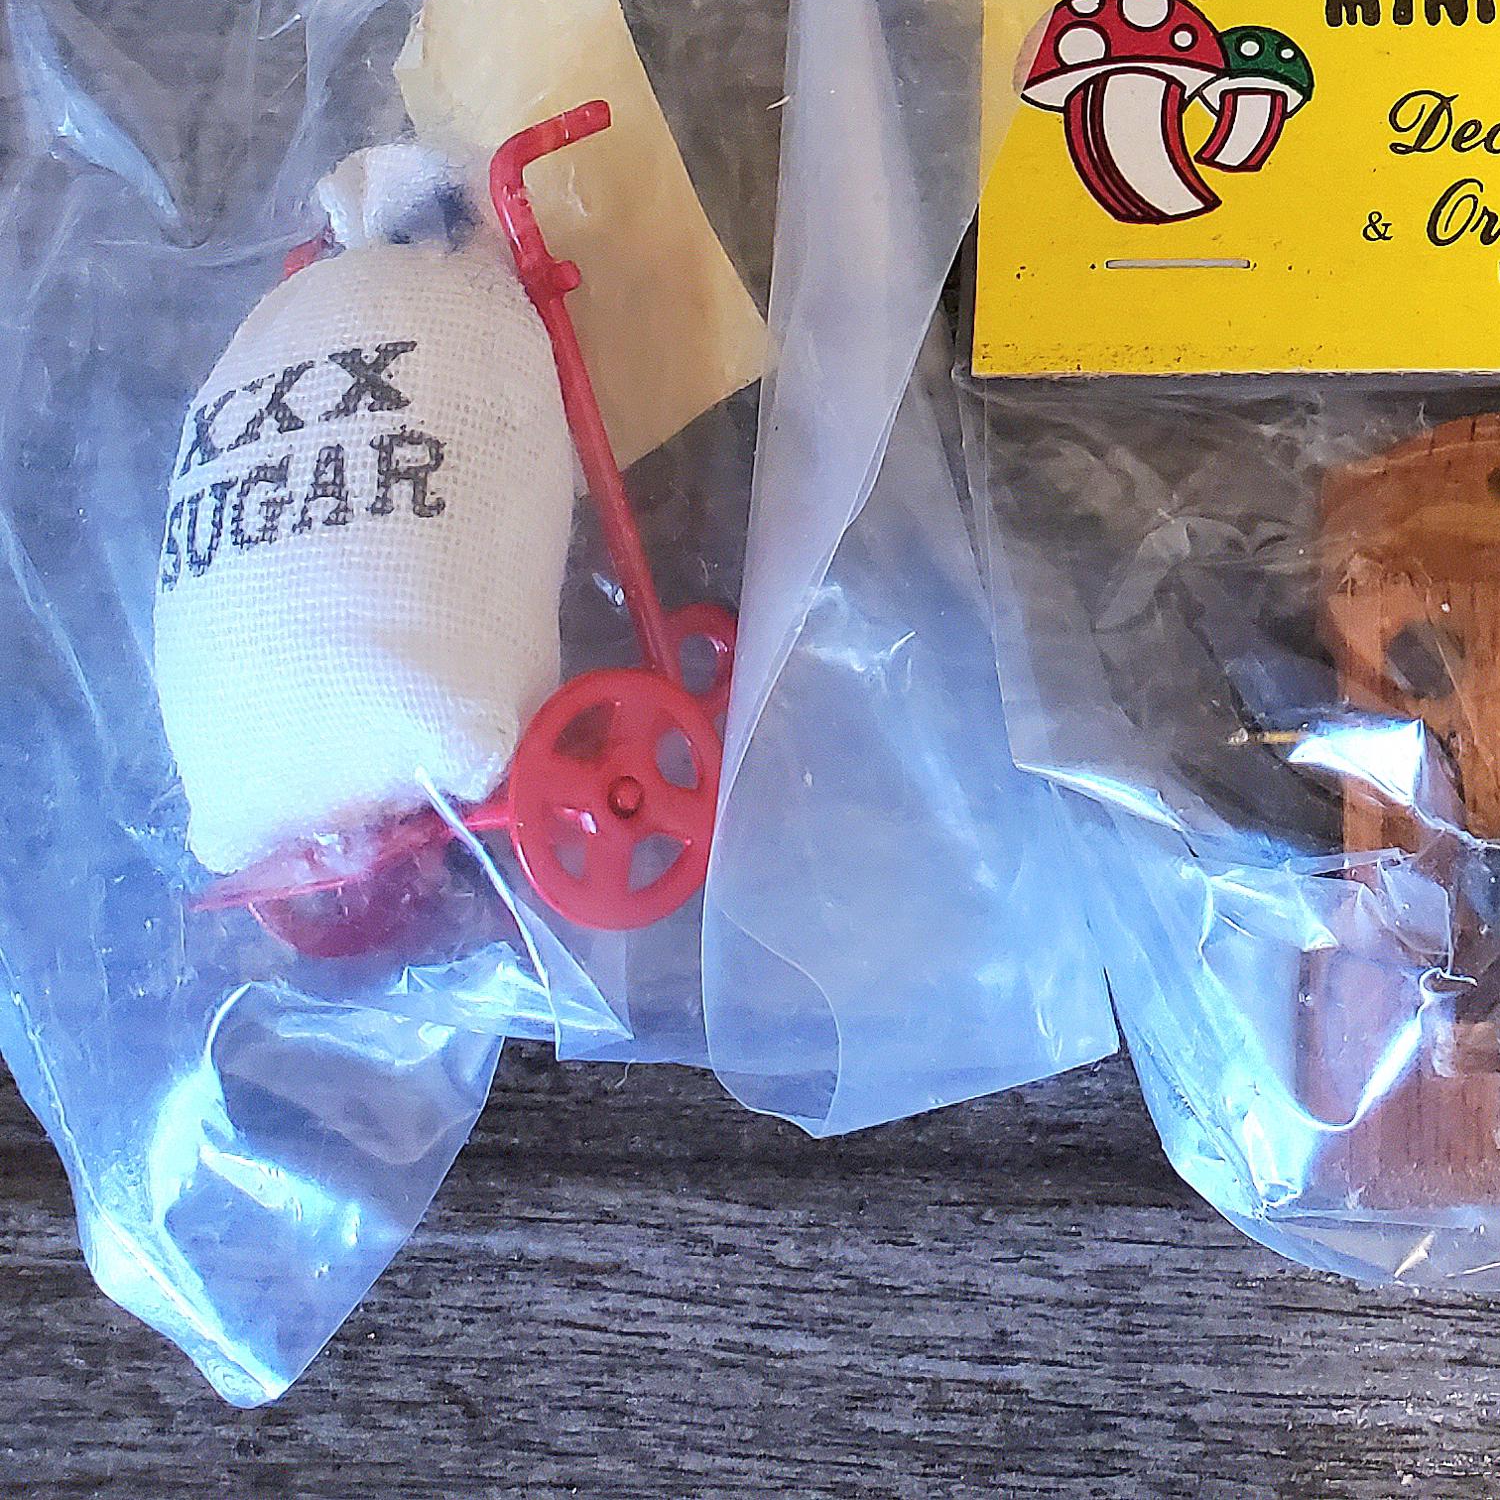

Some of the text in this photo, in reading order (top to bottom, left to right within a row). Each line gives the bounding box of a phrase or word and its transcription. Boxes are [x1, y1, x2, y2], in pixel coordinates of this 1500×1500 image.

[1362, 210, 1394, 242] &
[180, 340, 417, 478] XXX
[161, 425, 447, 592] SUGAR
